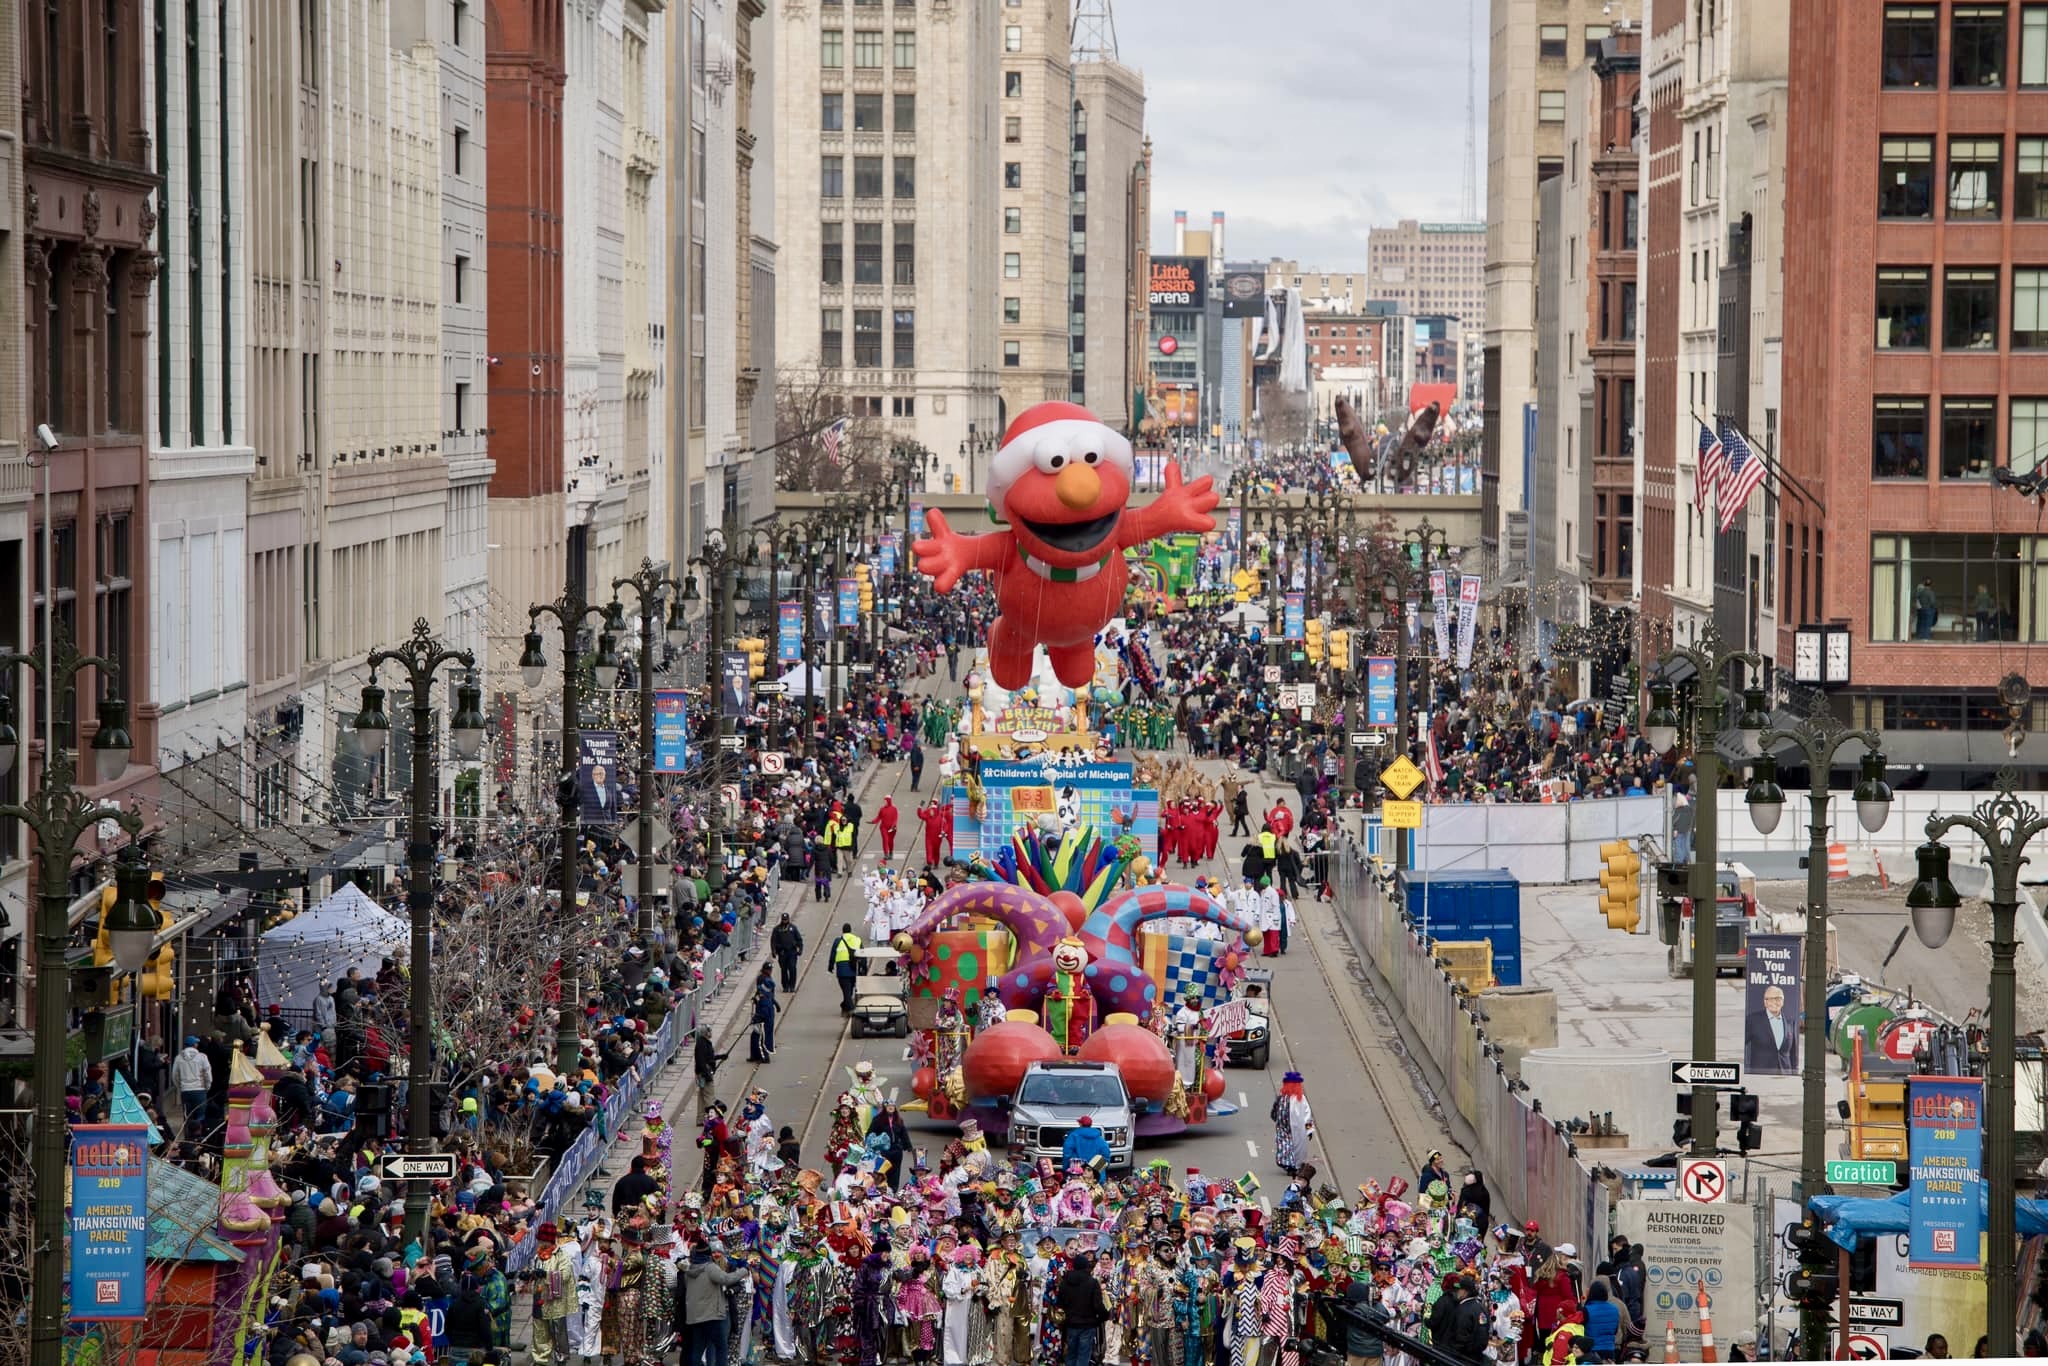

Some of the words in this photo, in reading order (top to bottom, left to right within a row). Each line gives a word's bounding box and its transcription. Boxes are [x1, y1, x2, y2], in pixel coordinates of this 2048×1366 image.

[1152, 264, 1189, 279] Little
[1150, 279, 1195, 292] aesars
[1150, 291, 1189, 303] arena
[1464, 584, 1477, 600] 4
[1300, 695, 1313, 703] 25
[1004, 708, 1053, 720] BRUSH
[997, 720, 1061, 734] HEALTHY
[592, 748, 606, 756] You
[598, 757, 612, 765] Van
[994, 768, 1038, 778] Children's
[1040, 770, 1076, 780] Hpital
[1078, 770, 1088, 778] of
[1090, 771, 1129, 782] Michigan
[1755, 948, 1791, 960] Thank
[1764, 960, 1785, 972] You
[1750, 972, 1769, 984] Mr.
[1771, 973, 1795, 985] Van
[1690, 1069, 1710, 1078] ONE
[1713, 1069, 1733, 1078] WAY
[1934, 1130, 1956, 1140] 2019
[402, 1163, 422, 1171] ONE
[426, 1163, 446, 1171] WAY
[1922, 1156, 1968, 1168] AMERICA'S
[1834, 1164, 1888, 1181] Gratiot
[1910, 1166, 1980, 1183] THANKSGIVING
[98, 1178, 121, 1188] 2019
[1926, 1180, 1964, 1194] PARADE
[1922, 1196, 1968, 1204] DETROIT
[86, 1205, 132, 1216] AMERICA'S
[73, 1216, 144, 1231] THANKSGIVING
[1647, 1212, 1725, 1225] AUTHORIZED
[1647, 1224, 1700, 1234] PERSONNEL
[1702, 1226, 1724, 1235] ONLY
[90, 1230, 128, 1242] PARADE
[1938, 1232, 1952, 1240] Art
[86, 1247, 132, 1255] DETROIT
[1648, 1256, 1682, 1264] REQUIRED
[1939, 1269, 1971, 1280] VEHICLES
[1849, 1306, 1866, 1316] NE
[1870, 1307, 1894, 1318] WAY
